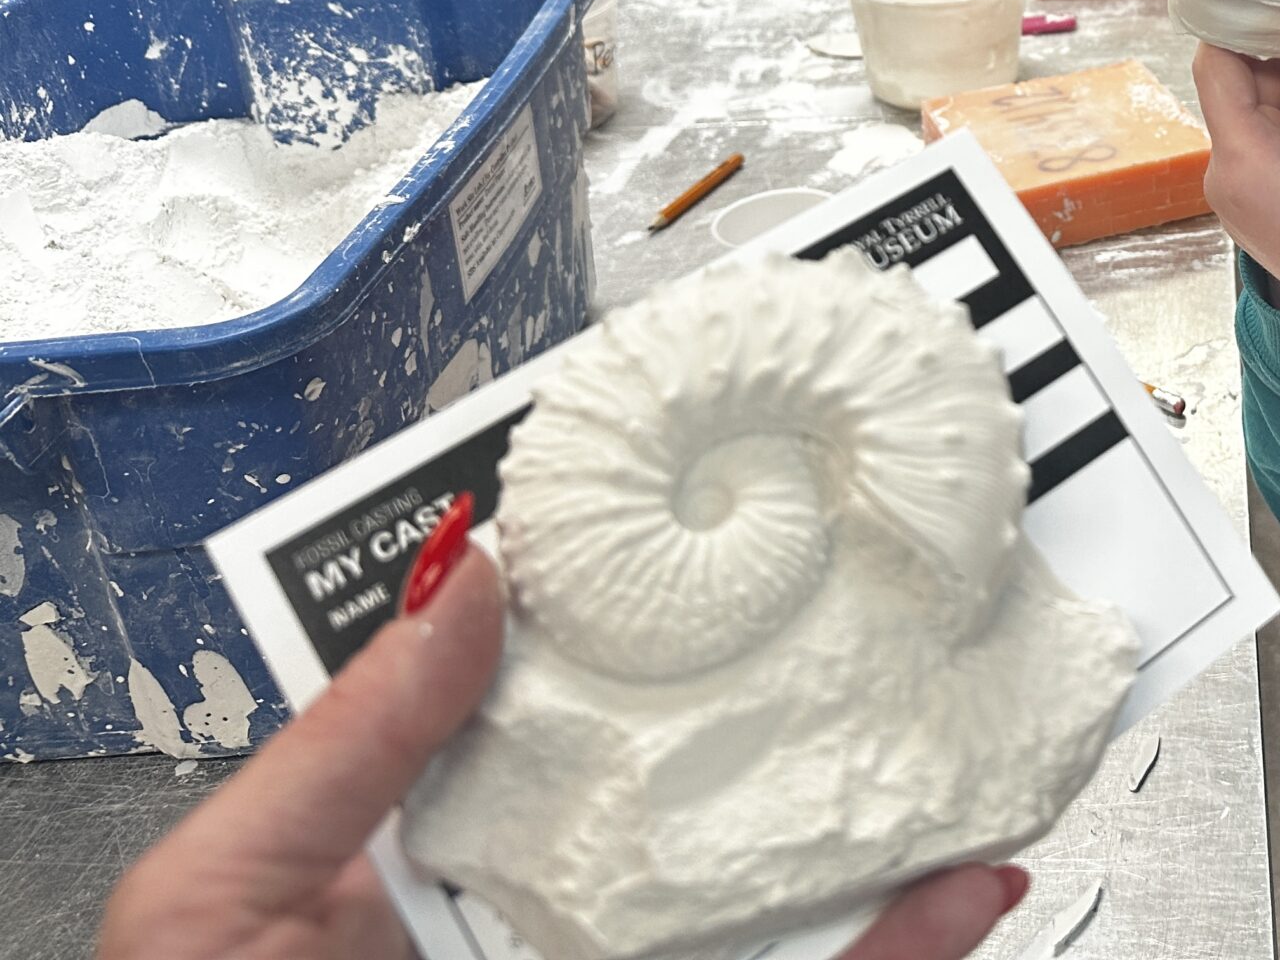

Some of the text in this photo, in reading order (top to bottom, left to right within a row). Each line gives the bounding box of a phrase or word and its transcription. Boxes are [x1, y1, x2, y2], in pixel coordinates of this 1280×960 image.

[865, 203, 964, 271] USEUM
[293, 486, 423, 570] FOSSIL CASTING
[304, 544, 363, 602] MY
